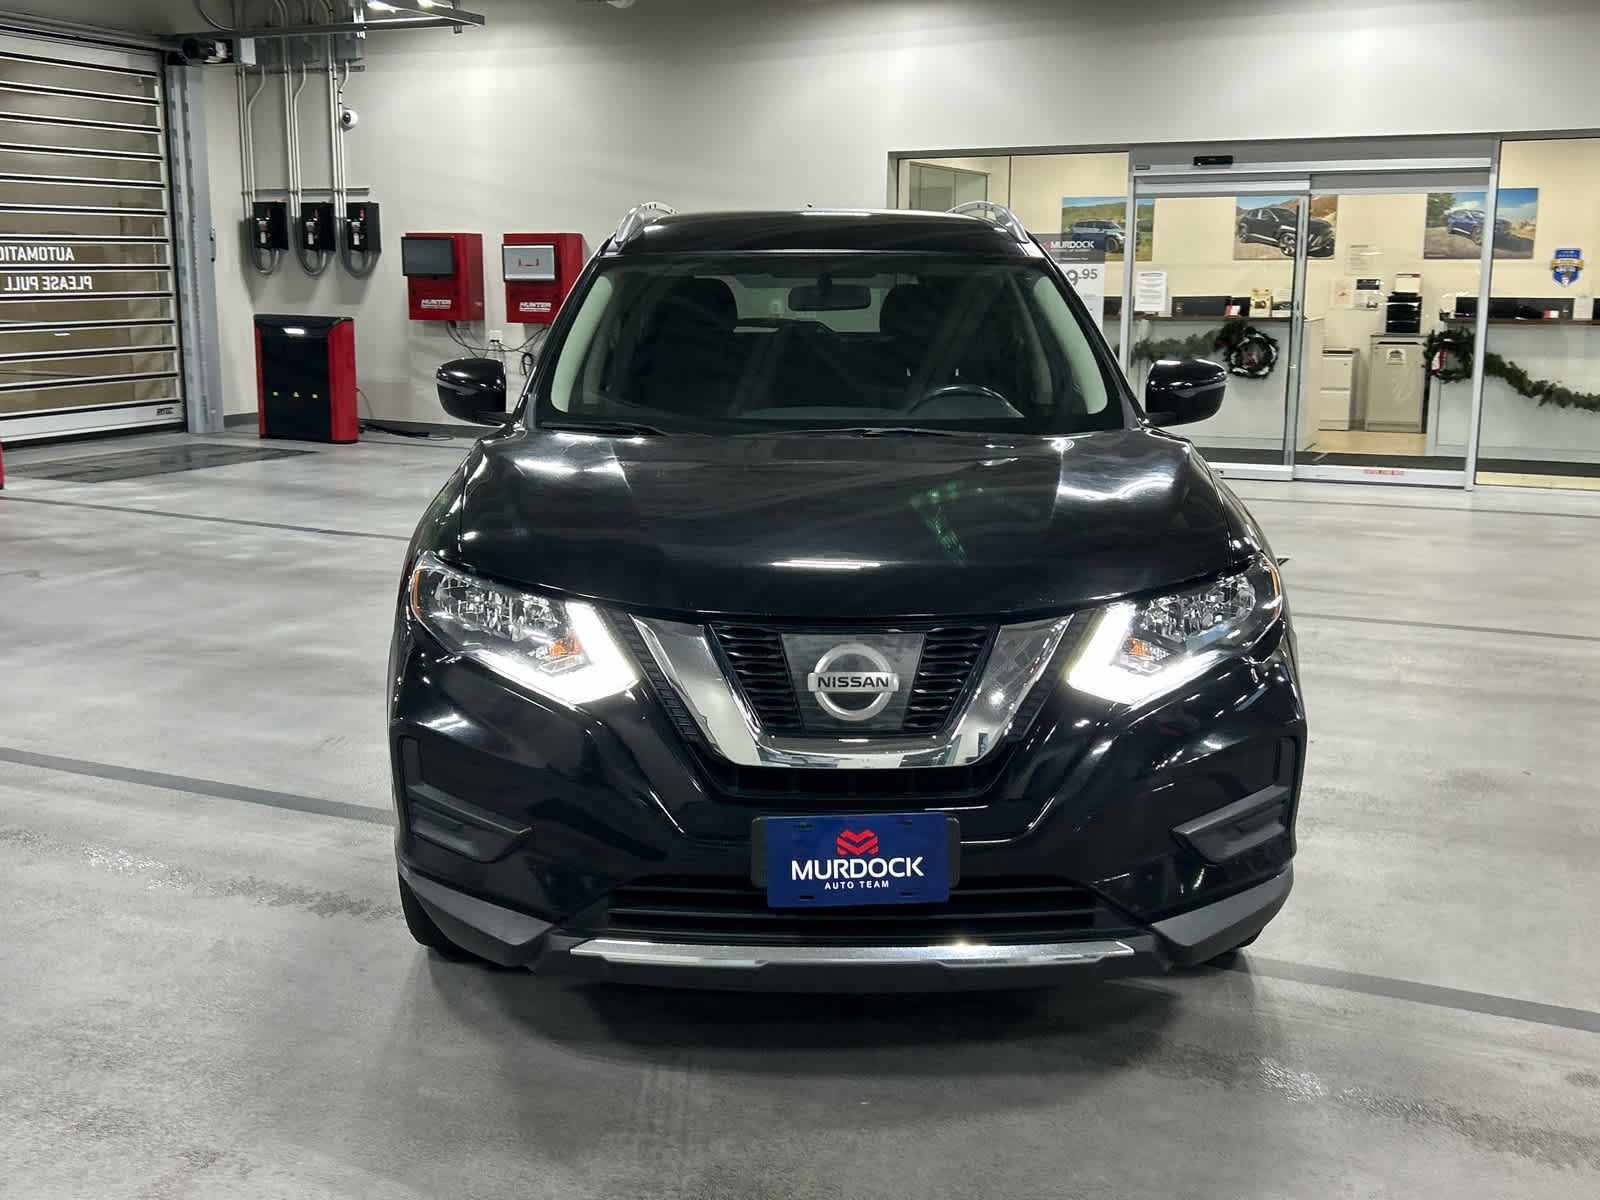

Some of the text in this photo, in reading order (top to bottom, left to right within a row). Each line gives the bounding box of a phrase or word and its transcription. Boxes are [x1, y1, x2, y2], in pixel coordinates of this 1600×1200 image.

[1050, 240, 1095, 249] MURDOCK
[817, 676, 889, 688] NISSAN
[791, 856, 925, 880] MURDOCK
[824, 880, 889, 890] AUTO TEAM
